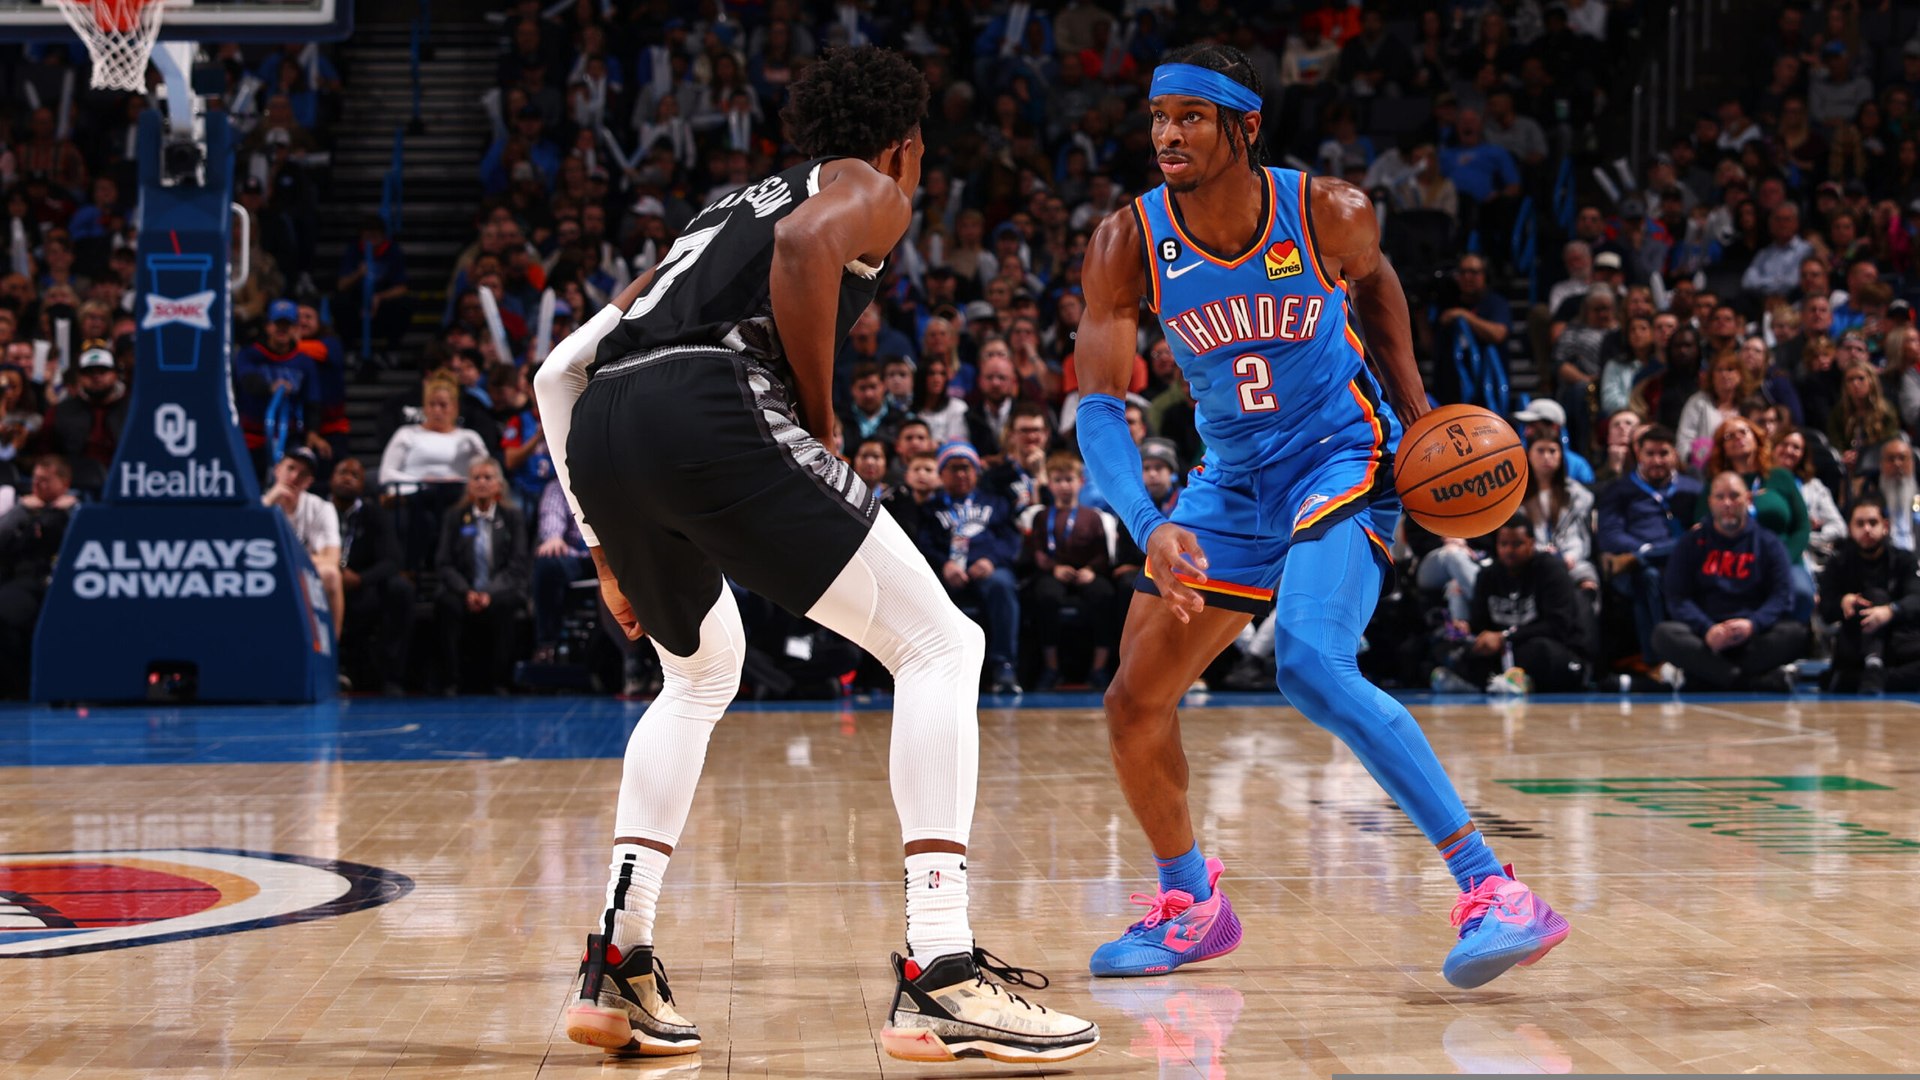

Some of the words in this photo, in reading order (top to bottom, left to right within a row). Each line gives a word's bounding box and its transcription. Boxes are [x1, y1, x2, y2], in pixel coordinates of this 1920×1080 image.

[622, 211, 733, 320] 7
[1162, 240, 1177, 260] 6
[153, 303, 205, 318] SONIC
[1165, 293, 1324, 356] THUNDER
[1232, 353, 1280, 414] 2
[154, 403, 197, 457] OU
[120, 458, 236, 498] Health
[1430, 459, 1518, 503] Wilson
[73, 538, 278, 570] ALWAYS
[72, 570, 277, 599] ONWARD
